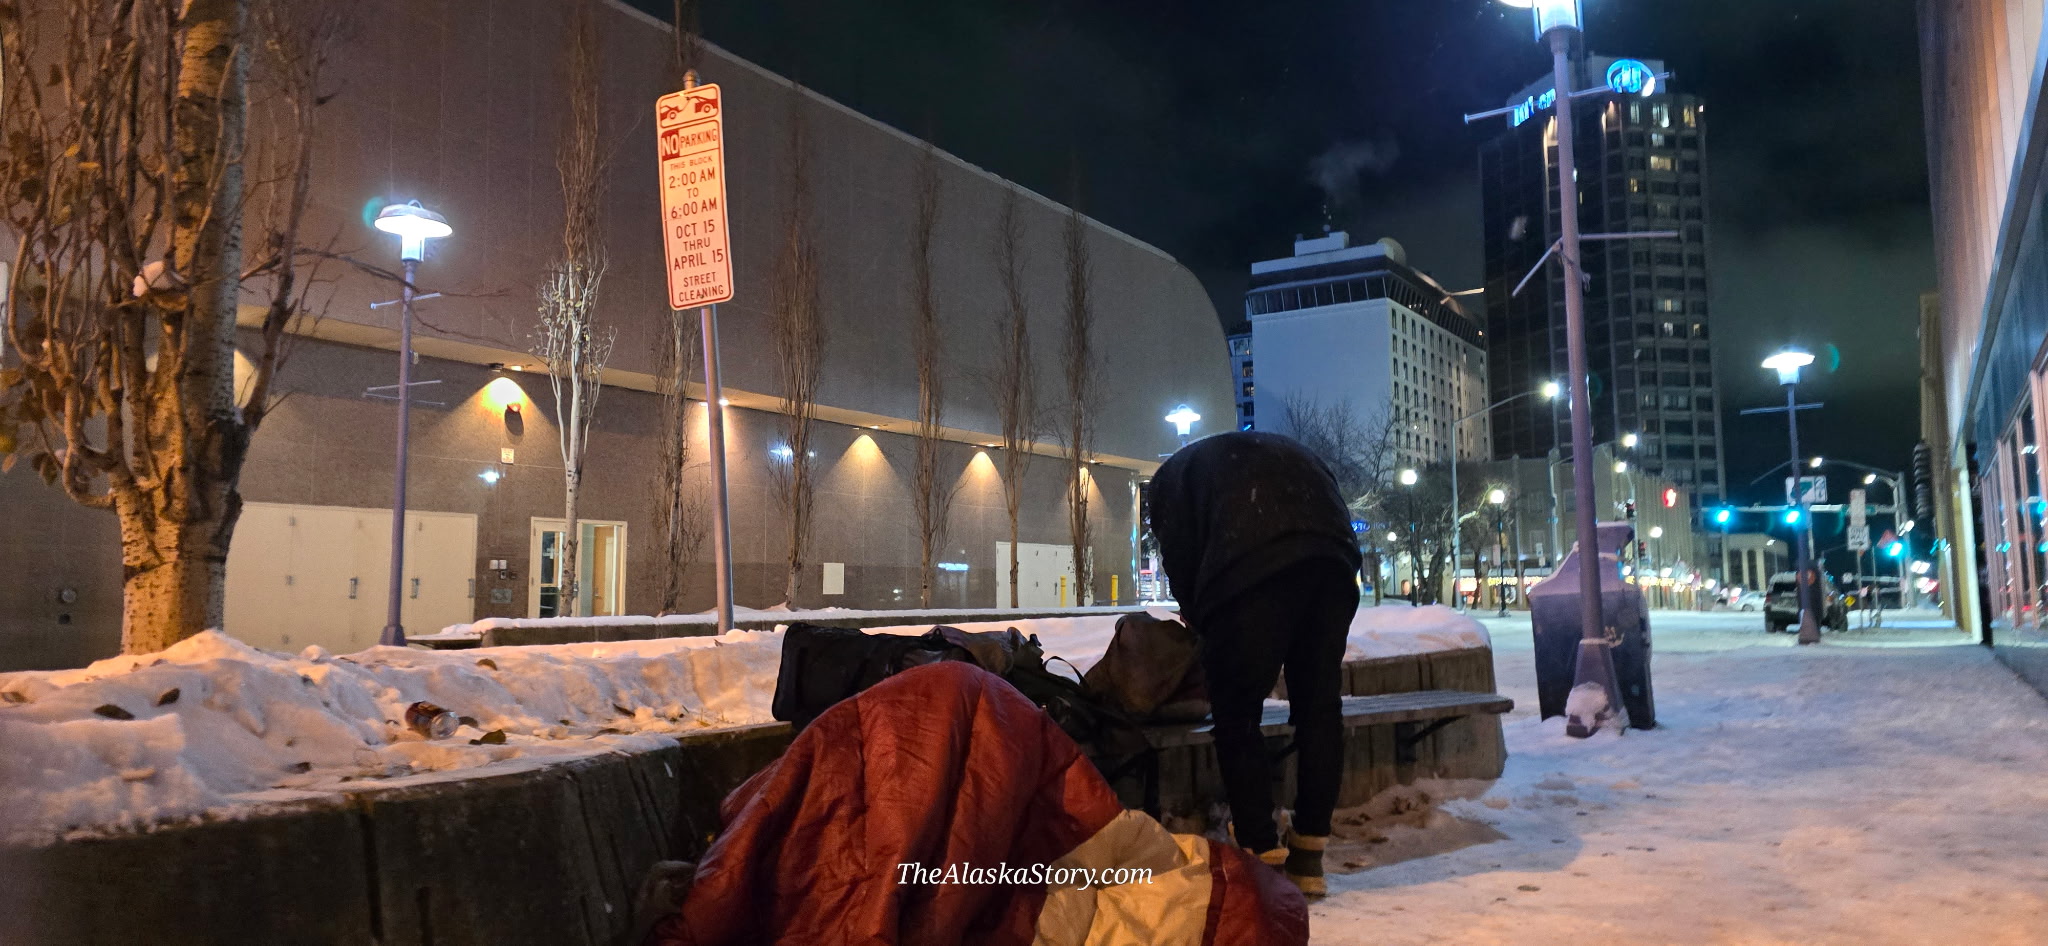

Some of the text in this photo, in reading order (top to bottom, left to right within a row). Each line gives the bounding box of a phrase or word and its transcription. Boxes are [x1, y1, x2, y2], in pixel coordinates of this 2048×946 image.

[662, 129, 717, 156] NO PARKING
[670, 156, 712, 170] THIS BLOCK
[669, 167, 715, 188] 2:00 AM
[687, 187, 699, 198] TO
[671, 197, 717, 219] 6:00 AM
[676, 219, 715, 239] OCT 15
[683, 237, 710, 251] THRU
[674, 249, 723, 270] APRIL 15
[684, 272, 716, 287] STREET
[679, 285, 724, 302] CLEANING
